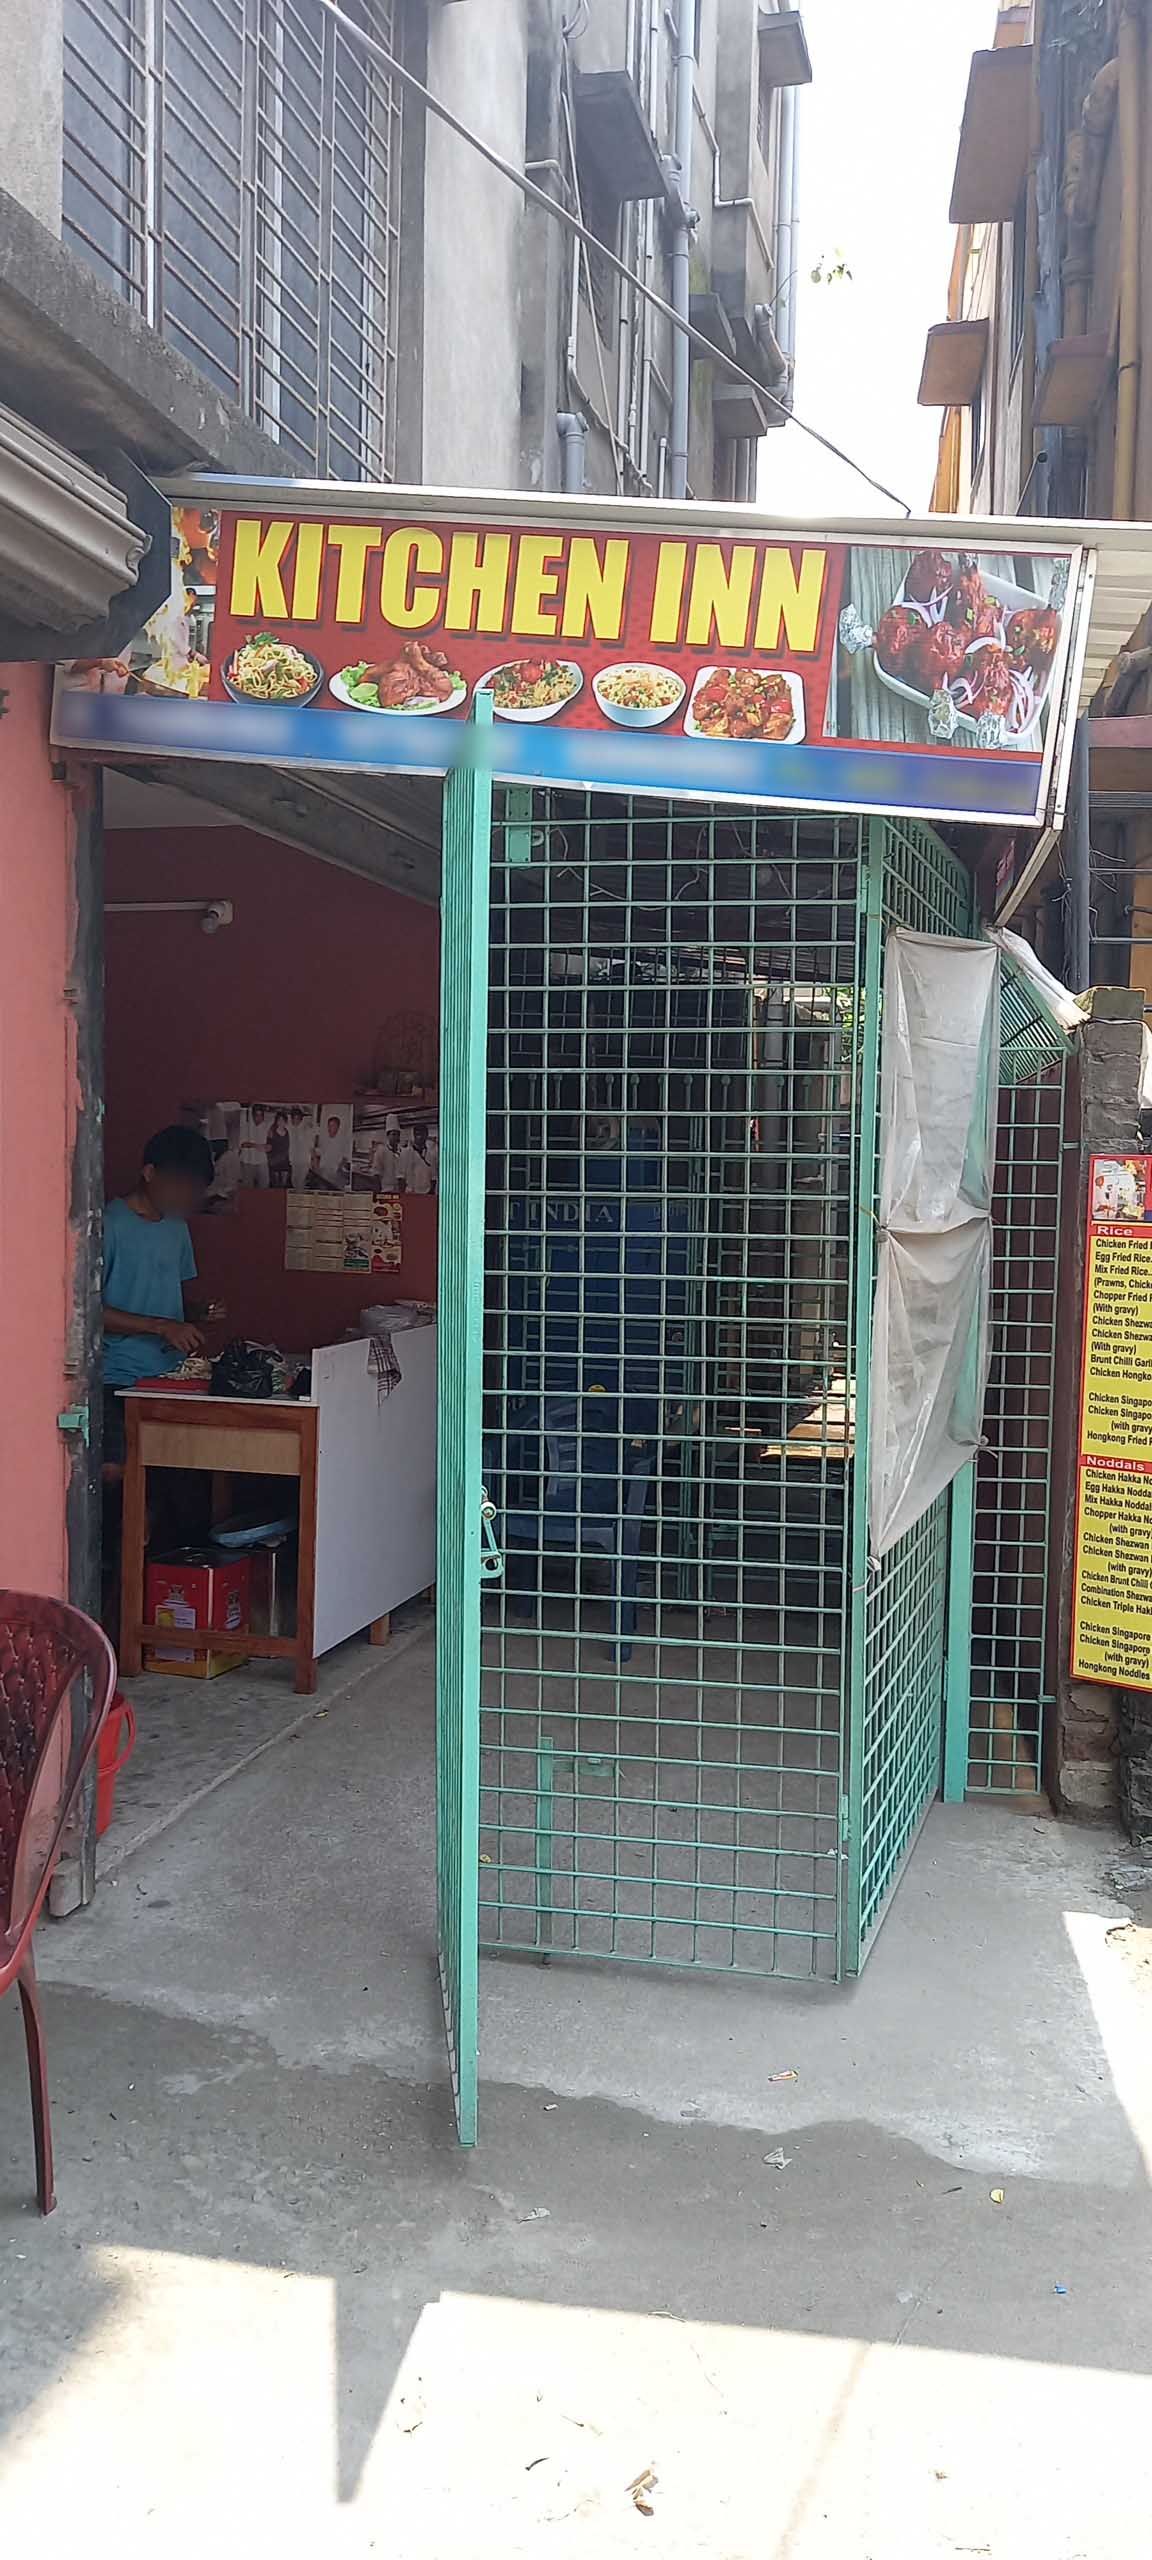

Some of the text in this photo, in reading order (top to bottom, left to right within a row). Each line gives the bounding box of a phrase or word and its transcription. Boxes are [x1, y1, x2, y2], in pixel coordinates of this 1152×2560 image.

[229, 519, 828, 652] KITCHEN INN
[528, 1202, 613, 1222] INDIA
[1097, 1225, 1133, 1236] Rice
[1096, 1239, 1126, 1249] Chicken
[1128, 1240, 1148, 1250] Fried
[1095, 1252, 1110, 1263] Egg
[1112, 1252, 1132, 1262] Fried
[1095, 1264, 1108, 1274] Mix
[1110, 1265, 1129, 1275] Fried
[1094, 1277, 1127, 1289] (Prawns,
[1094, 1290, 1126, 1301] Chopper
[1128, 1292, 1147, 1302] Fried
[1093, 1303, 1139, 1316] (With gravy)
[1092, 1316, 1123, 1326] Chicken
[1092, 1329, 1122, 1339] Chicken
[1091, 1342, 1137, 1355] (With gravy)
[1091, 1354, 1112, 1364] Brunt
[1090, 1367, 1121, 1377] Chicken
[1089, 1392, 1119, 1403] Chicken
[1088, 1405, 1119, 1416] Chicken
[1111, 1420, 1130, 1431] (with
[1087, 1430, 1126, 1445] Hongkong
[1127, 1434, 1147, 1445] Fried
[1086, 1456, 1145, 1471] Noddals
[1086, 1469, 1116, 1480] Chicken
[1118, 1472, 1141, 1483] Hakka
[1085, 1481, 1100, 1493] Egg
[1102, 1483, 1125, 1494] Hakka
[1085, 1494, 1098, 1504] Mix
[1100, 1496, 1123, 1507] Hakka
[1084, 1507, 1117, 1520] Chopper
[1118, 1511, 1141, 1522] Hakka
[1109, 1523, 1128, 1534] (with
[1083, 1532, 1113, 1544] Chicken
[1083, 1545, 1149, 1563] Chicken Shezwan
[1108, 1561, 1126, 1572] (with
[1082, 1570, 1108, 1582] Chicken
[1110, 1574, 1129, 1586] Brunt
[1081, 1583, 1125, 1597] Combination
[1081, 1595, 1111, 1609] Chicken
[1113, 1601, 1134, 1613] Triple
[1080, 1621, 1151, 1640] Chicken Singapore
[1080, 1634, 1151, 1654] Chicken Singapore
[1104, 1651, 1149, 1669] (with gravy)
[1079, 1659, 1150, 1680] Hongkong Noddles
